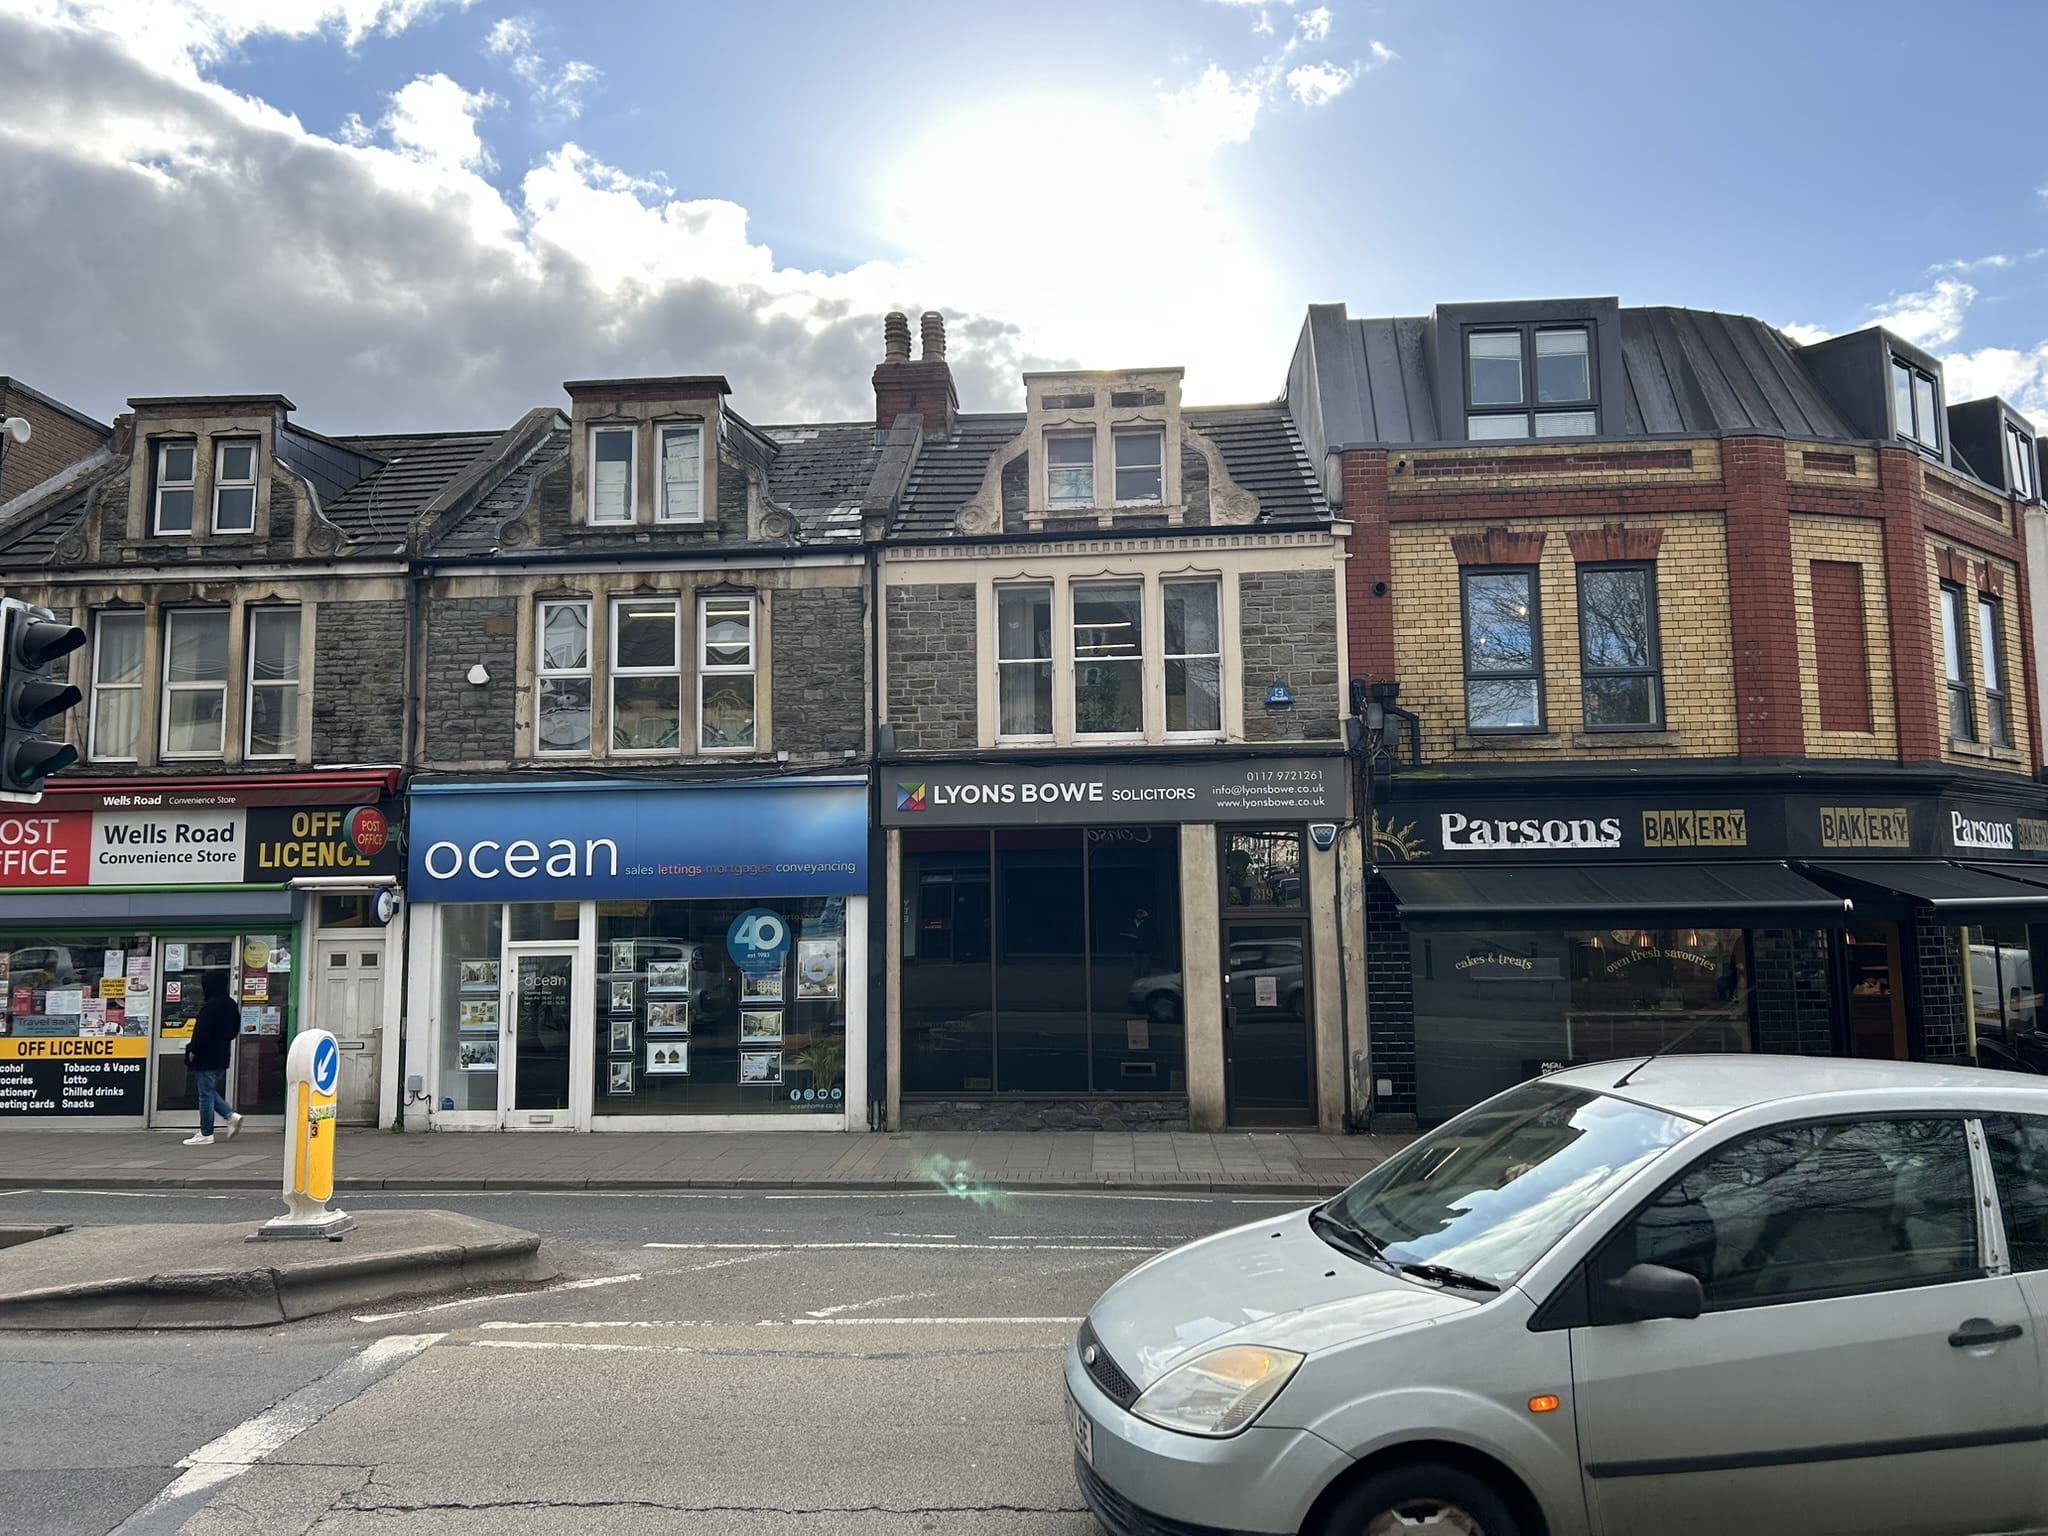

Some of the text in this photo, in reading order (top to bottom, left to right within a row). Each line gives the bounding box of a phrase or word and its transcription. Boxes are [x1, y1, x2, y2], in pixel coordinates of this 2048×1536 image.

[1246, 770, 1323, 782] 0117 9721261
[933, 782, 1196, 804] LYONS BOWE SOLICITORS
[1212, 783, 1325, 796] info@lyonsbowe.co.uk
[103, 795, 237, 806] Wells Road Convenience Store
[1216, 797, 1326, 809] www.lyonsbowe.co.uk
[291, 811, 342, 837] OFF
[361, 820, 381, 832] POST
[1440, 812, 1745, 844] Parsons BAKERY
[1822, 814, 1907, 841] BAKERY
[1950, 810, 2013, 845] Parsons
[104, 822, 235, 845] Wells Road
[357, 833, 384, 845] OFFICE
[0, 849, 67, 875] FICE
[99, 849, 237, 864] Convenience Store
[425, 838, 618, 879] ocean
[625, 861, 857, 877] sales lettings mortgages conveyancing
[1253, 887, 1274, 900] 319
[734, 915, 784, 951] 40
[1455, 952, 1533, 971] cakes & treats
[1606, 947, 1717, 974] oven fresh savouries
[524, 975, 567, 987] ocean
[17, 1040, 114, 1056] OFF LICENCE
[63, 1062, 141, 1074] Tobacco & Vapes
[1541, 1061, 1565, 1070] MEAL
[0, 1075, 34, 1085] oceries
[63, 1075, 88, 1085] Lotto
[62, 1086, 124, 1097] Chilled drinks
[29, 1099, 56, 1109] cards
[61, 1099, 95, 1109] Snacks
[311, 1126, 318, 1137] 3
